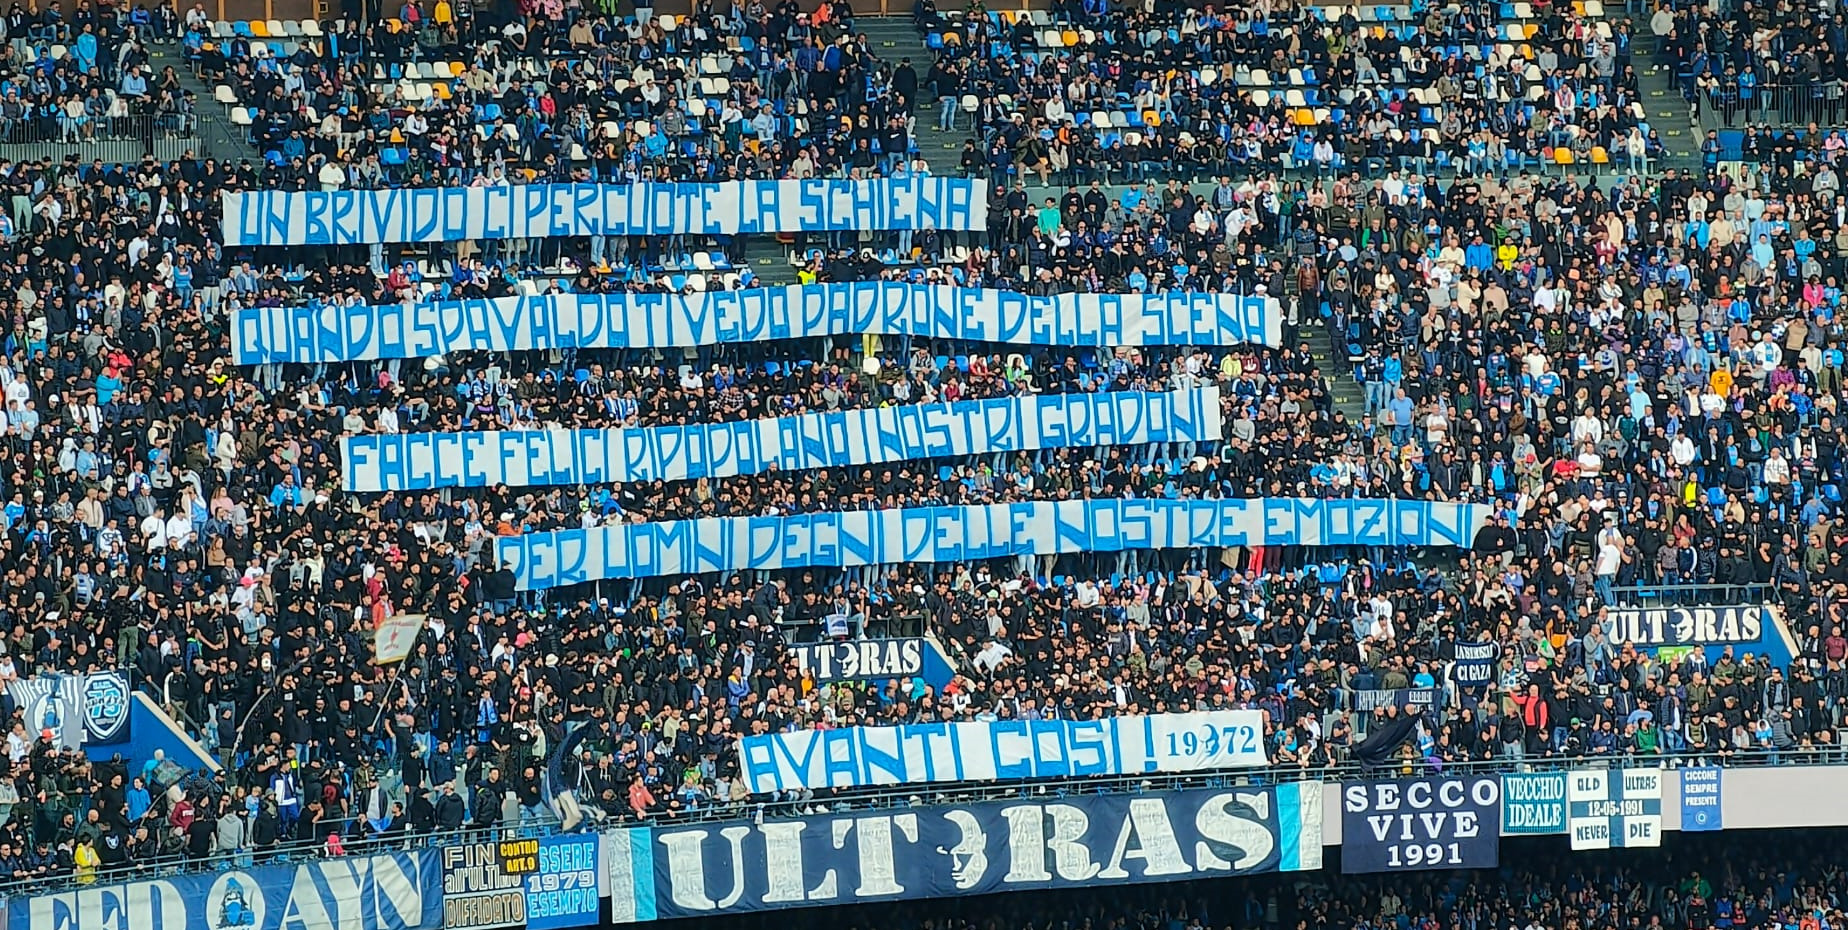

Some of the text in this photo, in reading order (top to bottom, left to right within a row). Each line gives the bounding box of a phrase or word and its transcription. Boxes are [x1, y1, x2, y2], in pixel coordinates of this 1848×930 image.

[240, 177, 973, 245] UN BRIVIDO CI PERCUOTE LA SCHIENA
[239, 281, 1267, 364] QUANDO SPAVALDO TI VEDO PADRONE DELLA SCENA
[348, 386, 1207, 491] FACCE FELICI RIPOPOLANO I NOSTRI GRADONI
[495, 499, 1472, 590] PER UOMINI DEGNI DELLE NOSTRE EMOZIONI
[1469, 664, 1491, 681] GAZA
[742, 723, 965, 793] AVANTI
[989, 716, 1122, 780] COSI
[1346, 779, 1499, 812] SECCO
[1507, 776, 1564, 800] VECCHIO
[1577, 775, 1657, 791] OLD ULTRAS
[1685, 783, 1718, 793] SEMPRE
[1685, 796, 1717, 806] PRESENTE
[1367, 811, 1480, 842] VIVE
[1509, 803, 1562, 827] IDEALE
[1576, 822, 1652, 841] NEVER DIE
[444, 842, 496, 869] FIN
[500, 840, 538, 857] CONTRO
[539, 842, 595, 873] SSERE
[1388, 842, 1462, 867] 1991
[528, 870, 595, 893] 1979
[445, 893, 525, 929] DIFFIDATO
[527, 887, 597, 918] ESEMPIO
